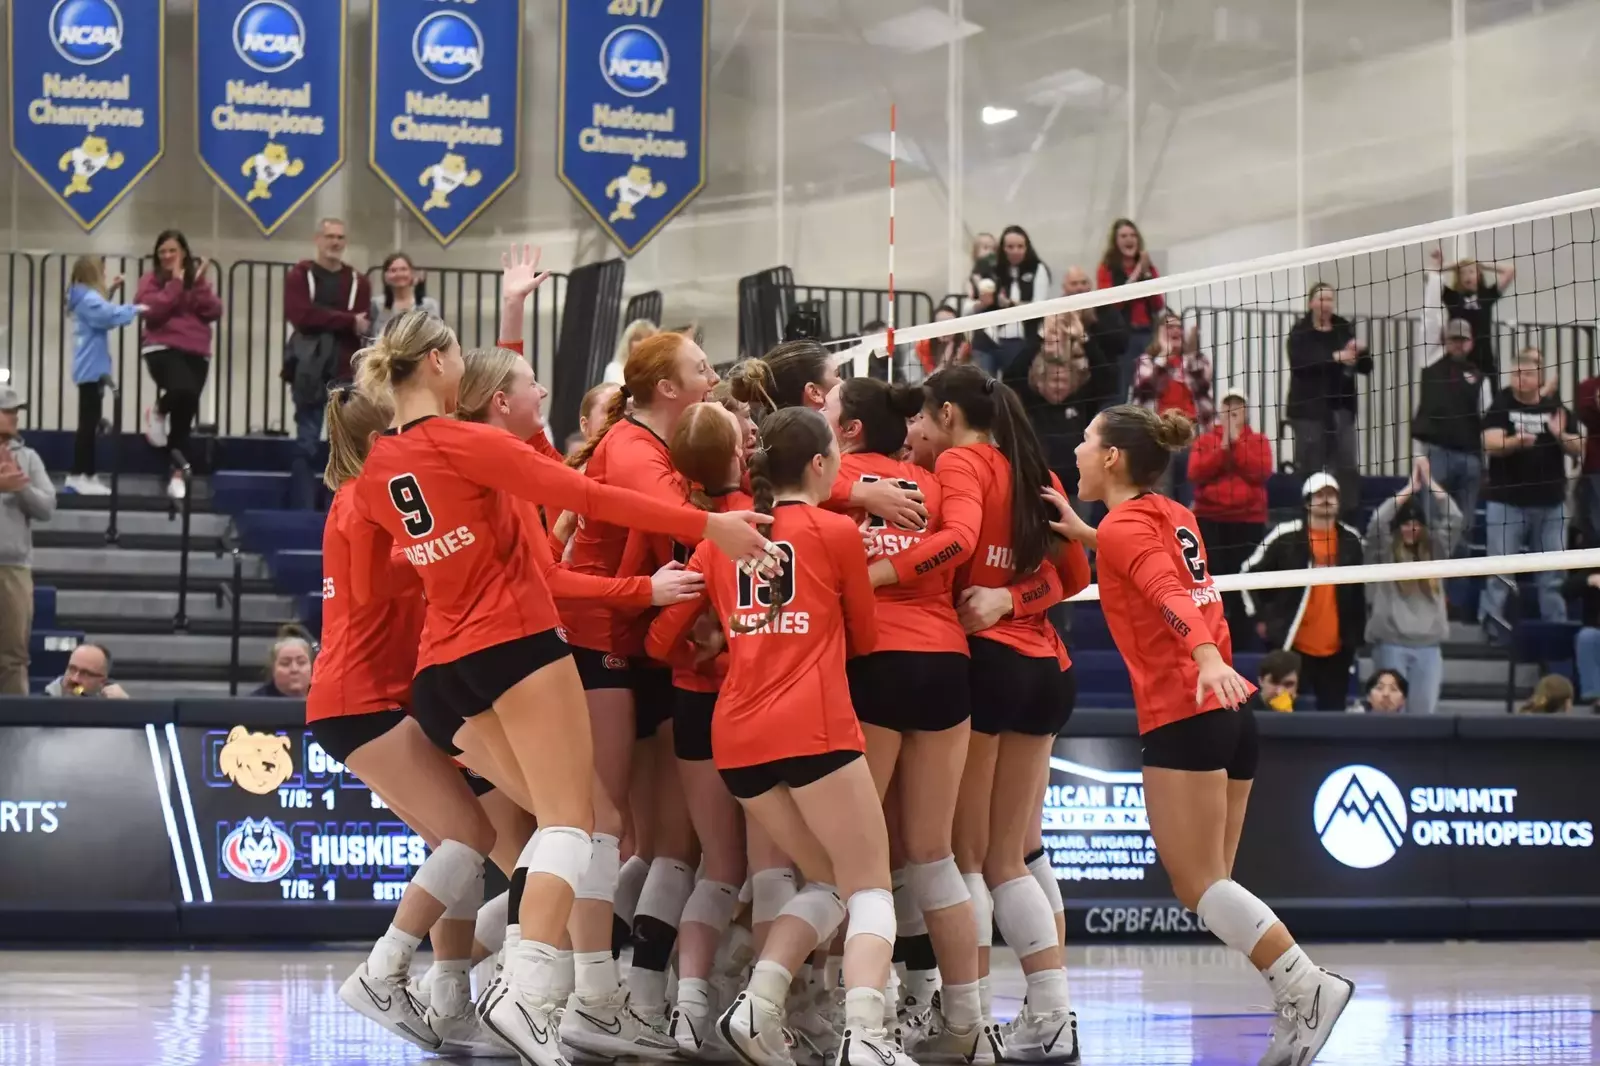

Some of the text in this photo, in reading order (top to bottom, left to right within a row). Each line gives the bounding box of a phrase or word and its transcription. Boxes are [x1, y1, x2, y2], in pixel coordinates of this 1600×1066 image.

[59, 25, 122, 51] NCAA
[242, 33, 304, 59] NCAA
[421, 45, 483, 71] NCAA
[609, 59, 667, 84] NCAA
[43, 73, 130, 100] National
[226, 80, 311, 108] National
[28, 99, 144, 132] Champions
[405, 90, 489, 119] National
[593, 103, 674, 132] National
[212, 104, 324, 139] Champions
[391, 115, 502, 149] Champions
[579, 128, 687, 162] Champions
[388, 472, 434, 539] 9
[1175, 526, 1205, 583] 2
[321, 788, 335, 810] 1
[1410, 787, 1517, 813] SUMMIT
[1412, 820, 1594, 847] ORTHOPEDICS
[311, 834, 426, 867] HUSKIES
[322, 879, 336, 900] 1
